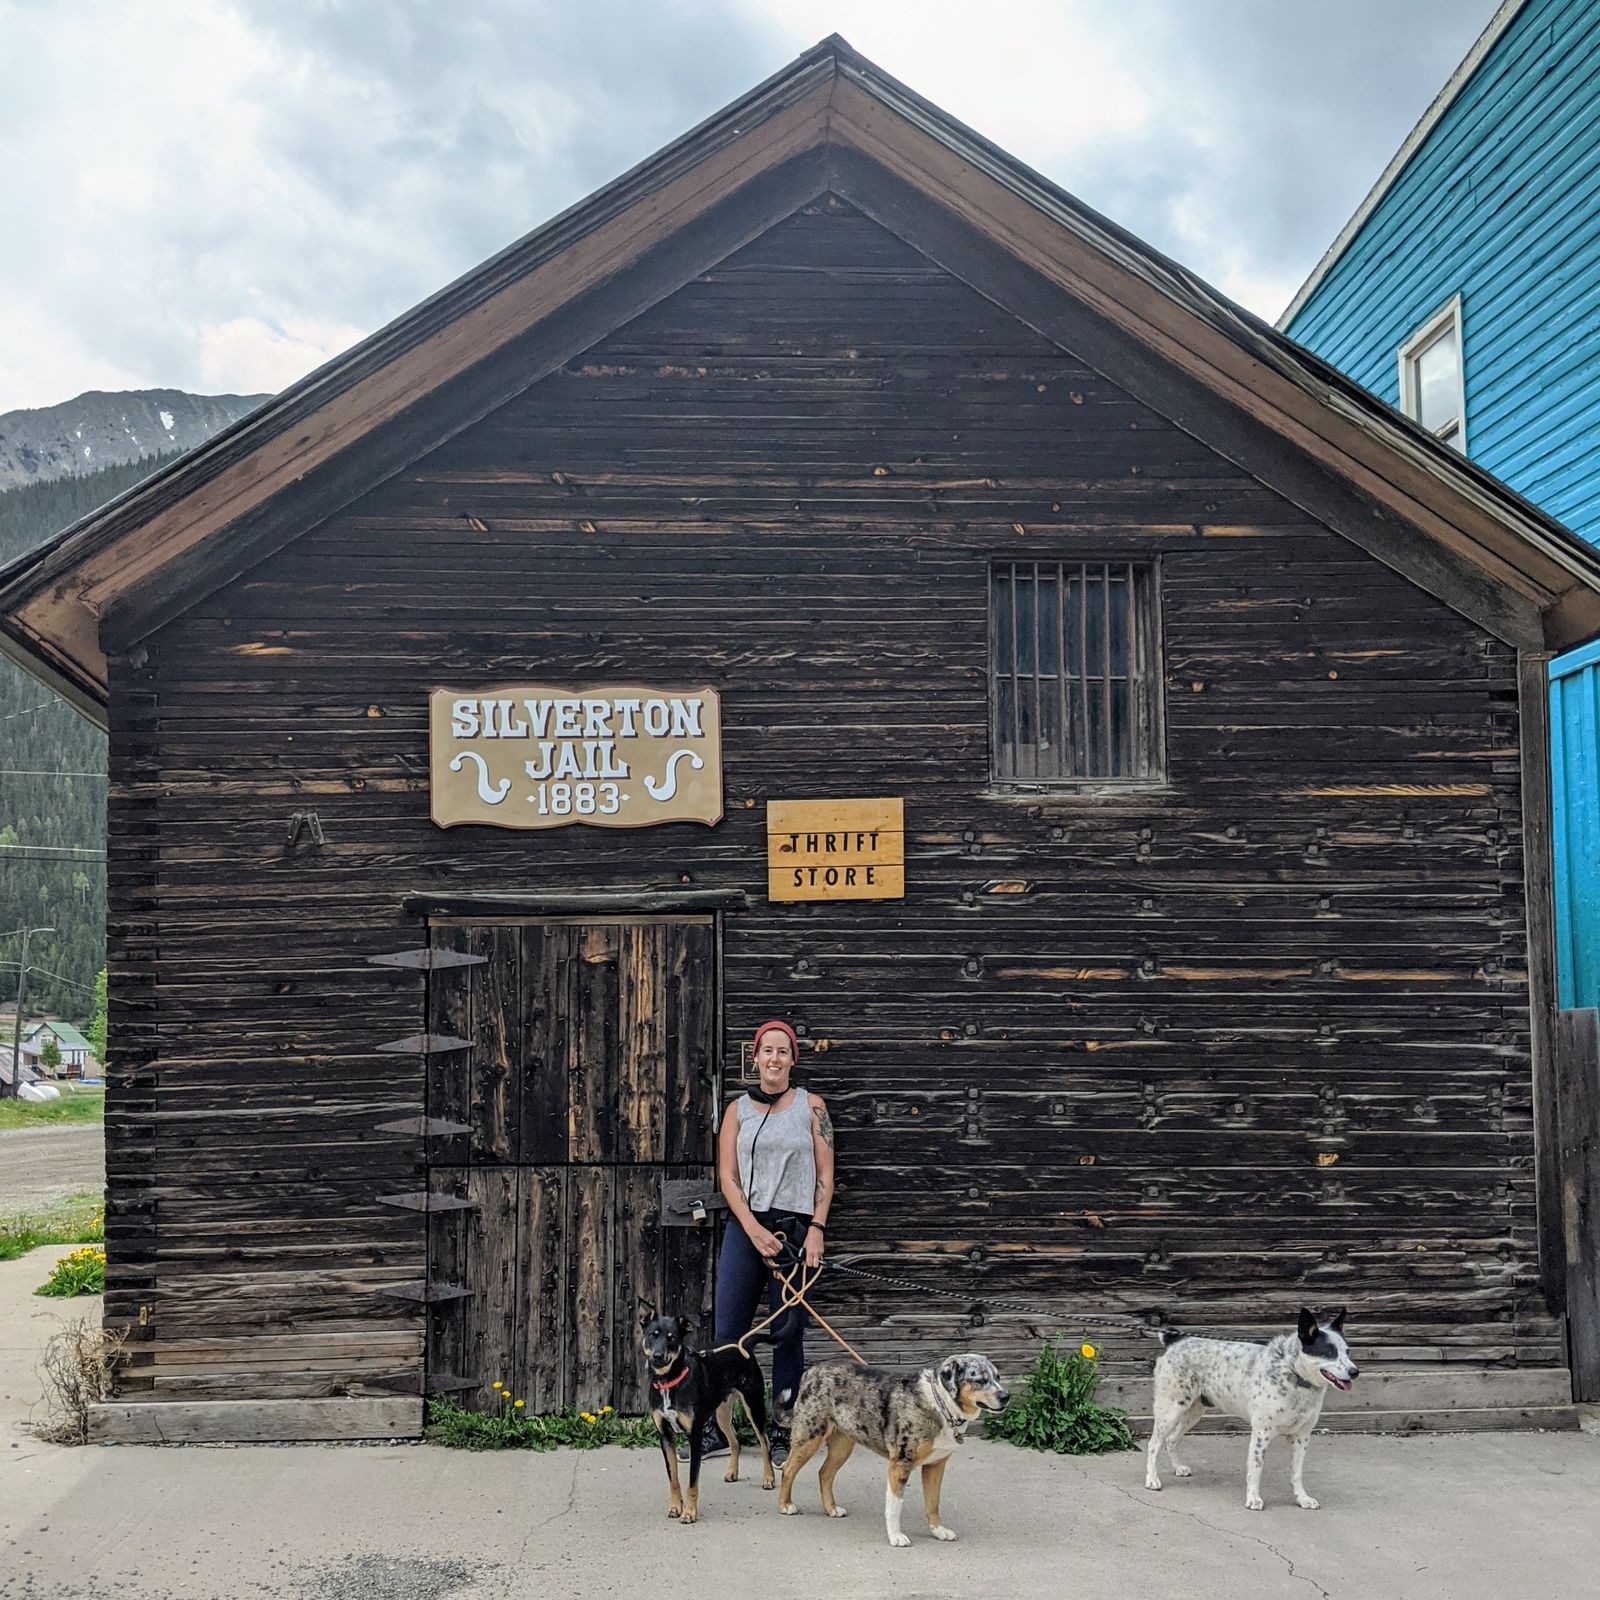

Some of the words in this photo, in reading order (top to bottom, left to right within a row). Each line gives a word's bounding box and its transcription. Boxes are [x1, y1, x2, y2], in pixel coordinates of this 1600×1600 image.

[450, 699, 705, 739] SILVERTON
[524, 741, 631, 780] JAIL
[537, 783, 620, 815] 1883
[789, 832, 880, 853] THRIFT
[793, 866, 875, 887] STORE
